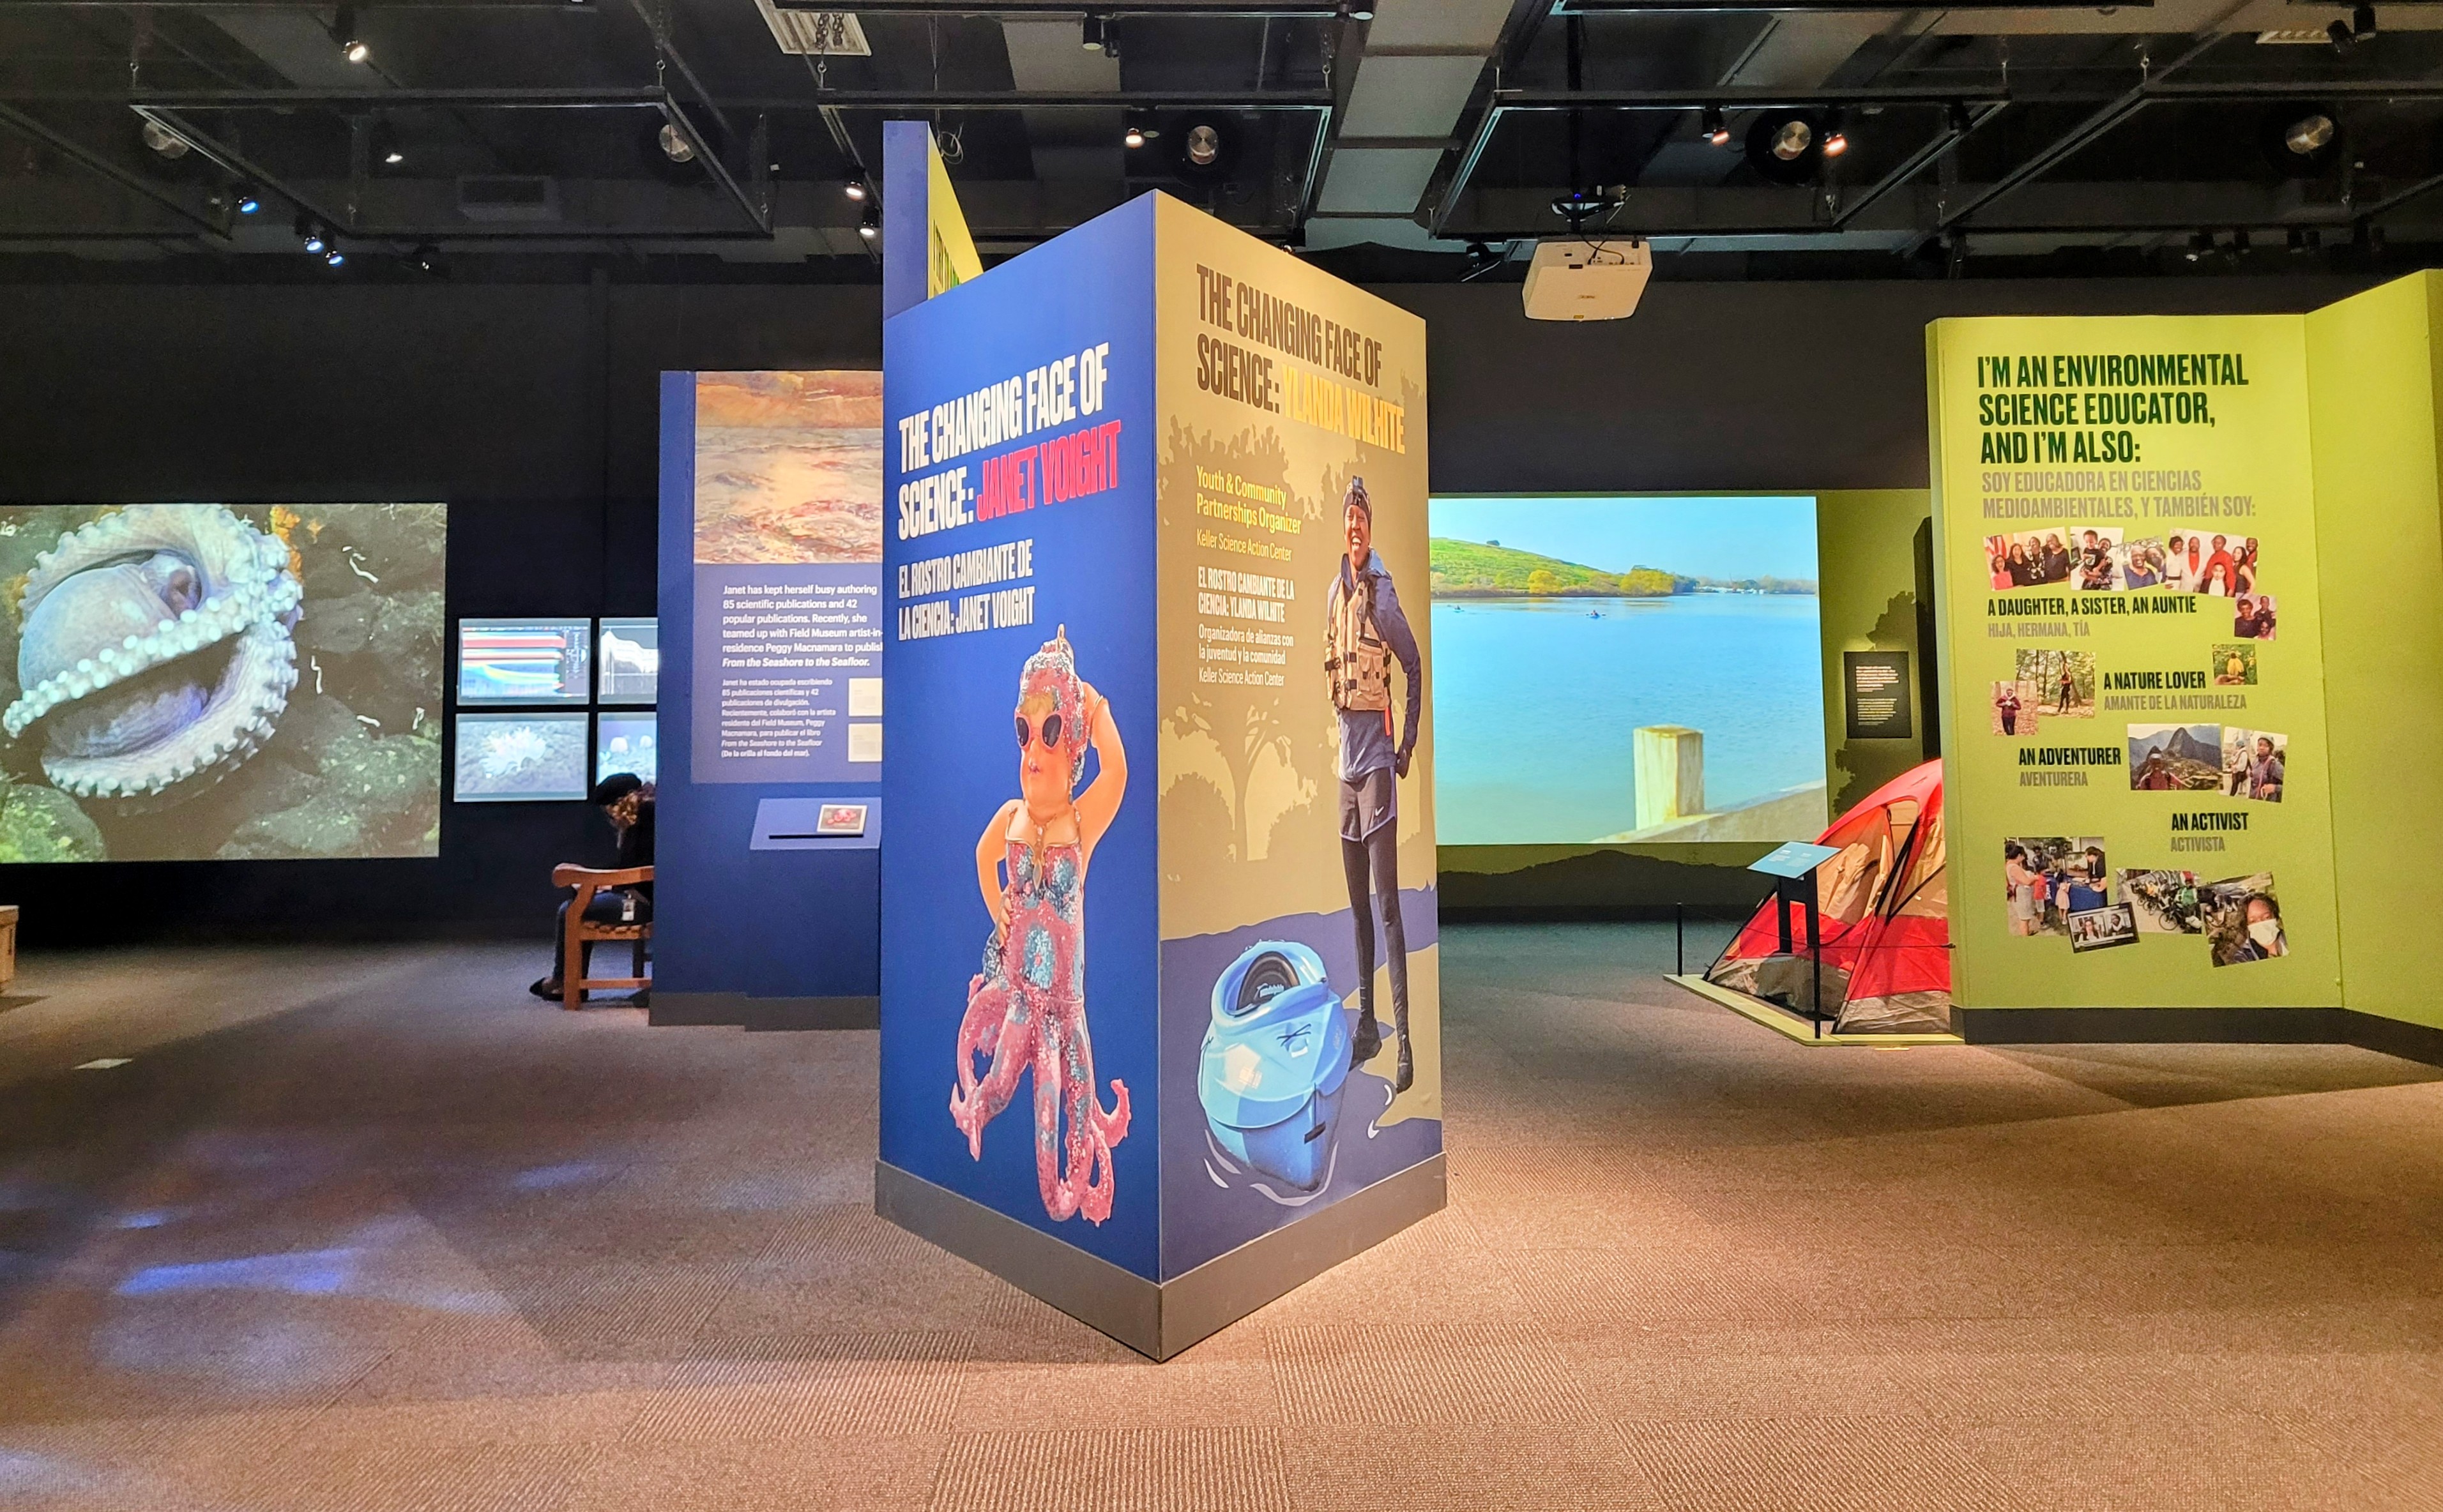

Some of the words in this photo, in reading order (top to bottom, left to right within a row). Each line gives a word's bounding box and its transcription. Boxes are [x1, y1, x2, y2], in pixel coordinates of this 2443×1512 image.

[1196, 262, 1233, 332] THE
[1237, 282, 1322, 366] CHANGING
[1325, 319, 1361, 381] FACE
[1364, 337, 1382, 388] OF
[1977, 356, 2011, 388] I'M
[2017, 356, 2047, 387] AN
[2053, 354, 2249, 387] ENVIRONMENTAL
[1197, 333, 1280, 414] SCIENCE:
[1282, 363, 1344, 435] YLANDA
[1345, 387, 1405, 455] WILHITE
[899, 409, 930, 473] THE
[932, 375, 1022, 464] CHANGING
[1026, 354, 1076, 434] FACE
[1080, 342, 1109, 416] OF
[1979, 393, 2079, 426] SCIENCE
[2085, 391, 2216, 427] EDUCATOR,
[1981, 432, 2028, 464] AND
[2034, 431, 2067, 464] I'M
[2073, 430, 2141, 463] ALSO:
[898, 466, 973, 540] SCIENCE:
[977, 445, 1037, 522] JANET
[1040, 420, 1121, 505] VOIGHT
[1196, 465, 1224, 493] Youth
[1226, 474, 1233, 495] &
[1235, 474, 1286, 511] Community
[1982, 472, 2012, 493] SOY
[2014, 471, 2106, 492] EDUCADORA
[2110, 471, 2128, 492] EN
[2131, 470, 2202, 492] CIENCIAS
[1196, 493, 1258, 529] Partnerships
[1258, 506, 1302, 535] Organizer
[1983, 496, 2138, 520] MEDIOAMBIENTALES,
[2140, 497, 2150, 517] Y
[2153, 492, 2219, 517] TAMBIÉN
[2223, 495, 2256, 517] SOY:
[1196, 528, 1217, 549] Keller
[1219, 533, 1246, 554] Science
[1247, 538, 1269, 558] Action
[1269, 543, 1292, 562] Center
[899, 564, 910, 598] EL
[911, 552, 951, 596] ROSTRO
[953, 542, 1016, 589] CAMBIANTE
[1017, 539, 1033, 577] DE
[723, 585, 746, 594] Janet
[747, 584, 763, 594] has
[764, 584, 783, 596] kept
[784, 584, 814, 594] herself
[815, 584, 835, 595] busy
[837, 584, 877, 596] authoring
[1198, 566, 1207, 588] EL
[1208, 567, 1237, 593] ROSTRO
[1238, 571, 1276, 598] CAMBIANTE
[1277, 577, 1285, 599] DE
[1286, 579, 1295, 600] LA
[723, 600, 734, 609] 85
[736, 599, 774, 609] scientific
[775, 599, 826, 610] publications
[828, 599, 844, 609] and
[846, 599, 857, 609] 42
[898, 607, 911, 641] LA
[912, 600, 954, 640] CIENCIA:
[955, 594, 991, 634] JANET
[991, 586, 1035, 629] VOIGHT
[1198, 592, 1229, 617] CIENCIA:
[1230, 596, 1256, 621] YLANDA
[1257, 600, 1286, 623] WILHITE
[1988, 598, 1995, 616] A
[1998, 597, 2069, 617] DAUGHTER,
[2071, 598, 2079, 615] A
[2081, 596, 2130, 616] SISTER,
[2132, 596, 2149, 614] AN
[2152, 596, 2196, 614] AUNTIE
[722, 614, 756, 625] popular
[757, 614, 811, 625] publications.
[812, 613, 850, 624] Recently,
[851, 613, 867, 623] she
[1988, 622, 2016, 639] HIJA,
[2018, 621, 2071, 639] HERMANA,
[2073, 619, 2090, 637] TÍA
[722, 628, 755, 639] teamed
[756, 630, 768, 640] up
[769, 628, 788, 638] with
[789, 628, 810, 637] Field
[811, 628, 848, 637] Museum
[849, 628, 883, 637] artist-in-
[1198, 623, 1245, 644] Organizadora
[1246, 628, 1254, 644] de
[1255, 629, 1281, 646] alianzas
[1282, 634, 1294, 647] con
[722, 642, 764, 653] residence
[765, 642, 792, 654] Peggy
[794, 643, 843, 652] Macnamara
[844, 643, 853, 652] to
[1199, 644, 1205, 660] la
[1206, 645, 1237, 664] juventud
[1238, 652, 1242, 665] y
[1243, 648, 1249, 663] la
[1250, 649, 1286, 665] comunidad
[722, 658, 745, 667] From
[746, 658, 761, 667] the
[762, 657, 803, 667] Seashore
[805, 658, 814, 667] to
[816, 657, 830, 667] the
[832, 656, 870, 667] Seafloor.
[1199, 667, 1217, 684] Keller
[1219, 669, 1244, 685] Science
[1244, 669, 1263, 686] Action
[1264, 671, 1284, 686] Center
[2104, 672, 2112, 690] A
[2114, 672, 2163, 690] NATURE
[2165, 670, 2206, 689] LOVER
[2104, 695, 2147, 711] AMANTE
[2149, 695, 2164, 710] DE
[2165, 695, 2178, 710] LA
[2179, 694, 2247, 710] NATURALEZA
[2019, 748, 2036, 766] AN
[2038, 747, 2121, 766] ADVENTURER
[2020, 771, 2089, 787] AVENTURERA
[2172, 813, 2188, 831] AN
[2191, 812, 2249, 831] ACTIVIST
[2171, 836, 2225, 852] ACTIVISTA
